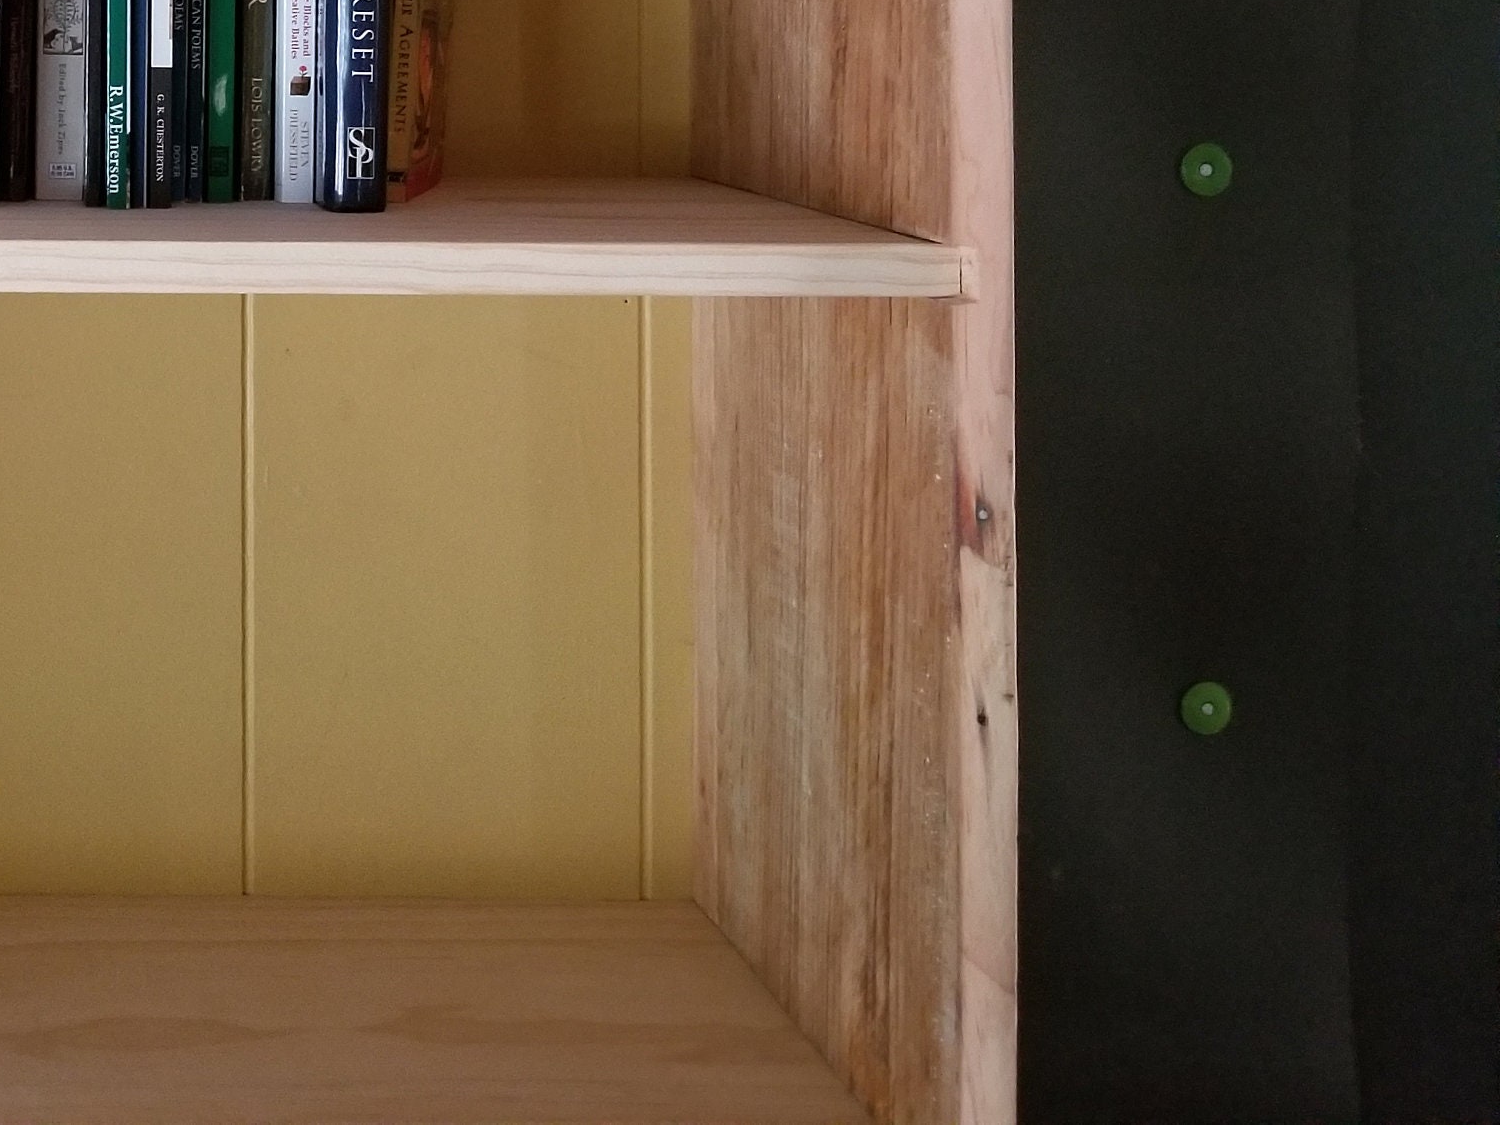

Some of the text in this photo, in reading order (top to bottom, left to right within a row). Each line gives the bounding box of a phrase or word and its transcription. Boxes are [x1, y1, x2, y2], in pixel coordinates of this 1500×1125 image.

[190, 28, 202, 70] POEMS
[291, 28, 301, 60] Battles
[302, 5, 312, 37] Blocks
[302, 38, 312, 57] and
[393, 24, 414, 133] AGREEMENTS
[106, 84, 125, 195] R.W.Emerson
[155, 117, 165, 182] CHESTERTON
[250, 77, 263, 173] LOIS LOWRY
[289, 108, 299, 182] PRESSFIELD
[300, 121, 309, 168] STEVEN
